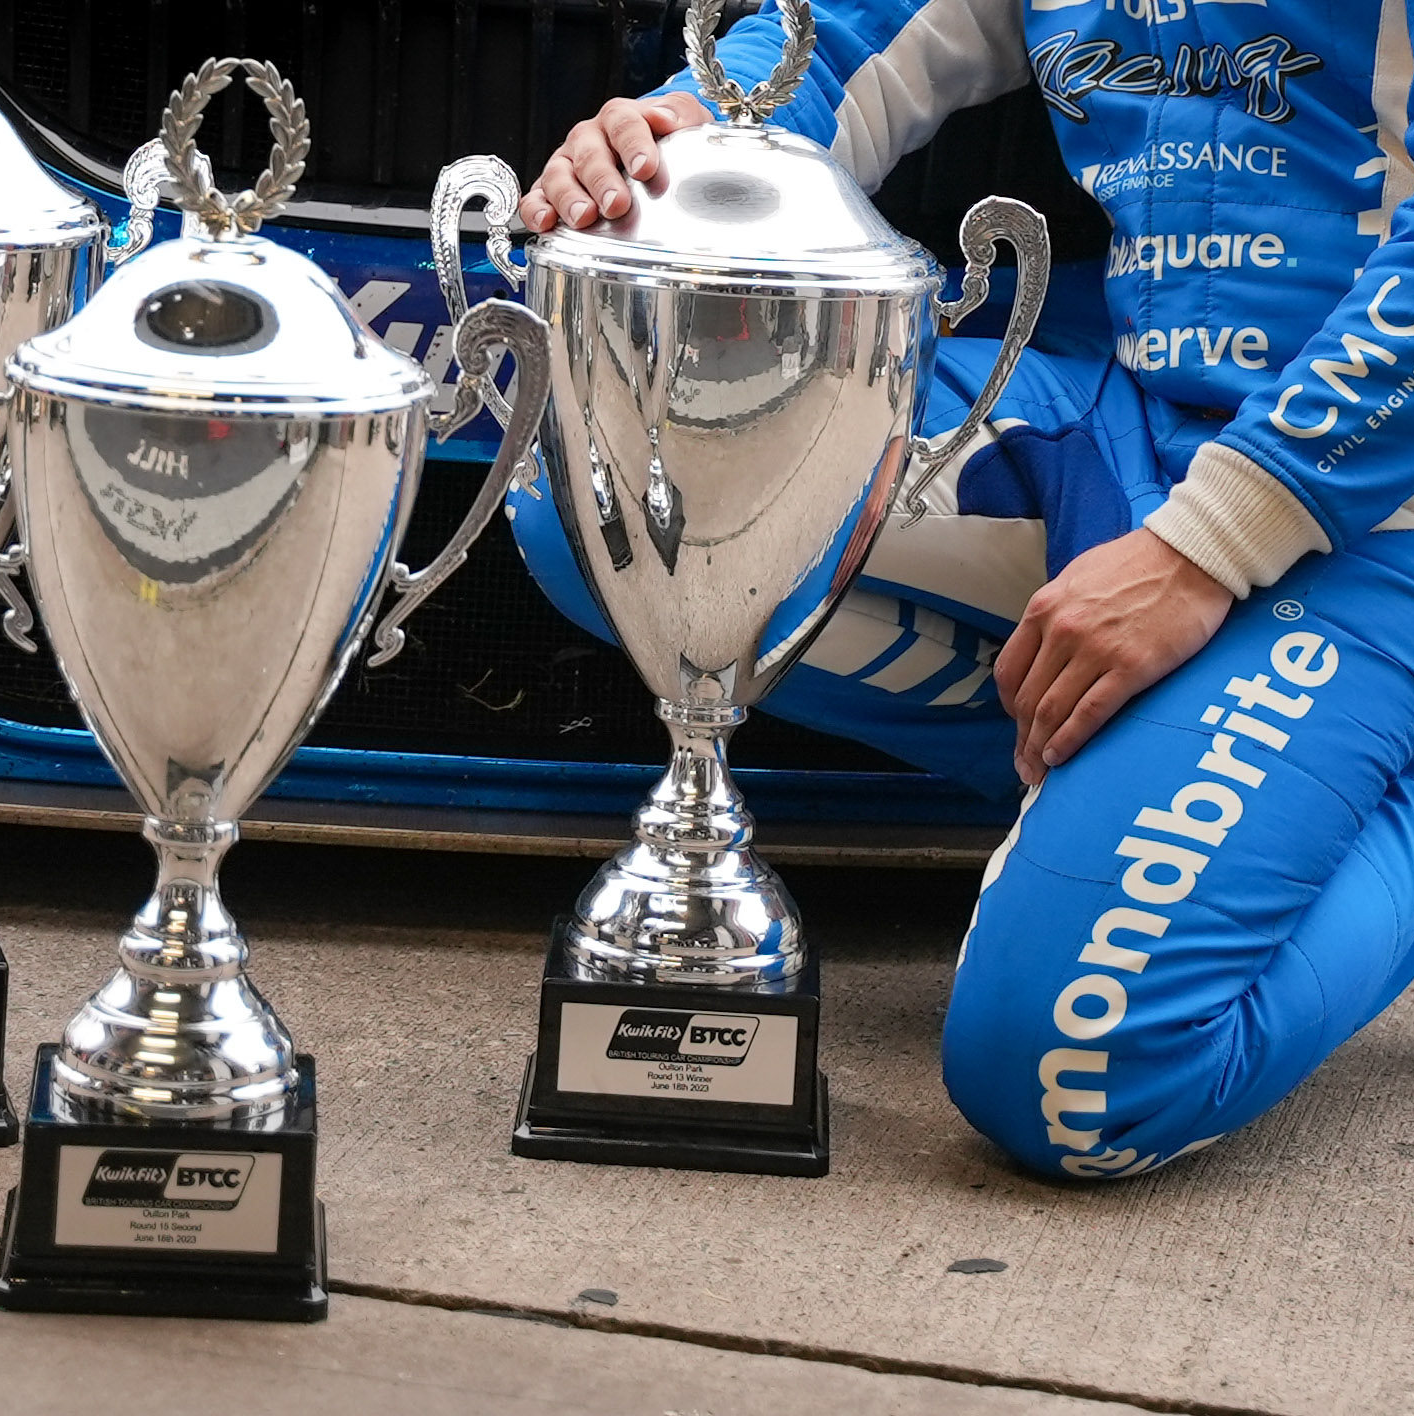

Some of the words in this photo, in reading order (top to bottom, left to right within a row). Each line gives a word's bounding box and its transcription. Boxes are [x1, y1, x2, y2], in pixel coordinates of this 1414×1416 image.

[1315, 431, 1366, 476] CIVIL
[690, 1025, 747, 1047] BTCC
[637, 1052, 670, 1061] TOURING
[670, 1054, 686, 1062] CAR
[685, 1064, 703, 1073] Park
[647, 1071, 673, 1081] Round
[675, 1073, 684, 1082] 13
[686, 1074, 714, 1083] Winner
[650, 1081, 670, 1090] June
[690, 1083, 709, 1092] 2023
[176, 1167, 241, 1188] BTCC
[171, 1210, 191, 1219] Park
[129, 1221, 157, 1230] Round
[171, 1222, 202, 1231] Second
[134, 1234, 154, 1242] June
[176, 1235, 197, 1244] 2023
